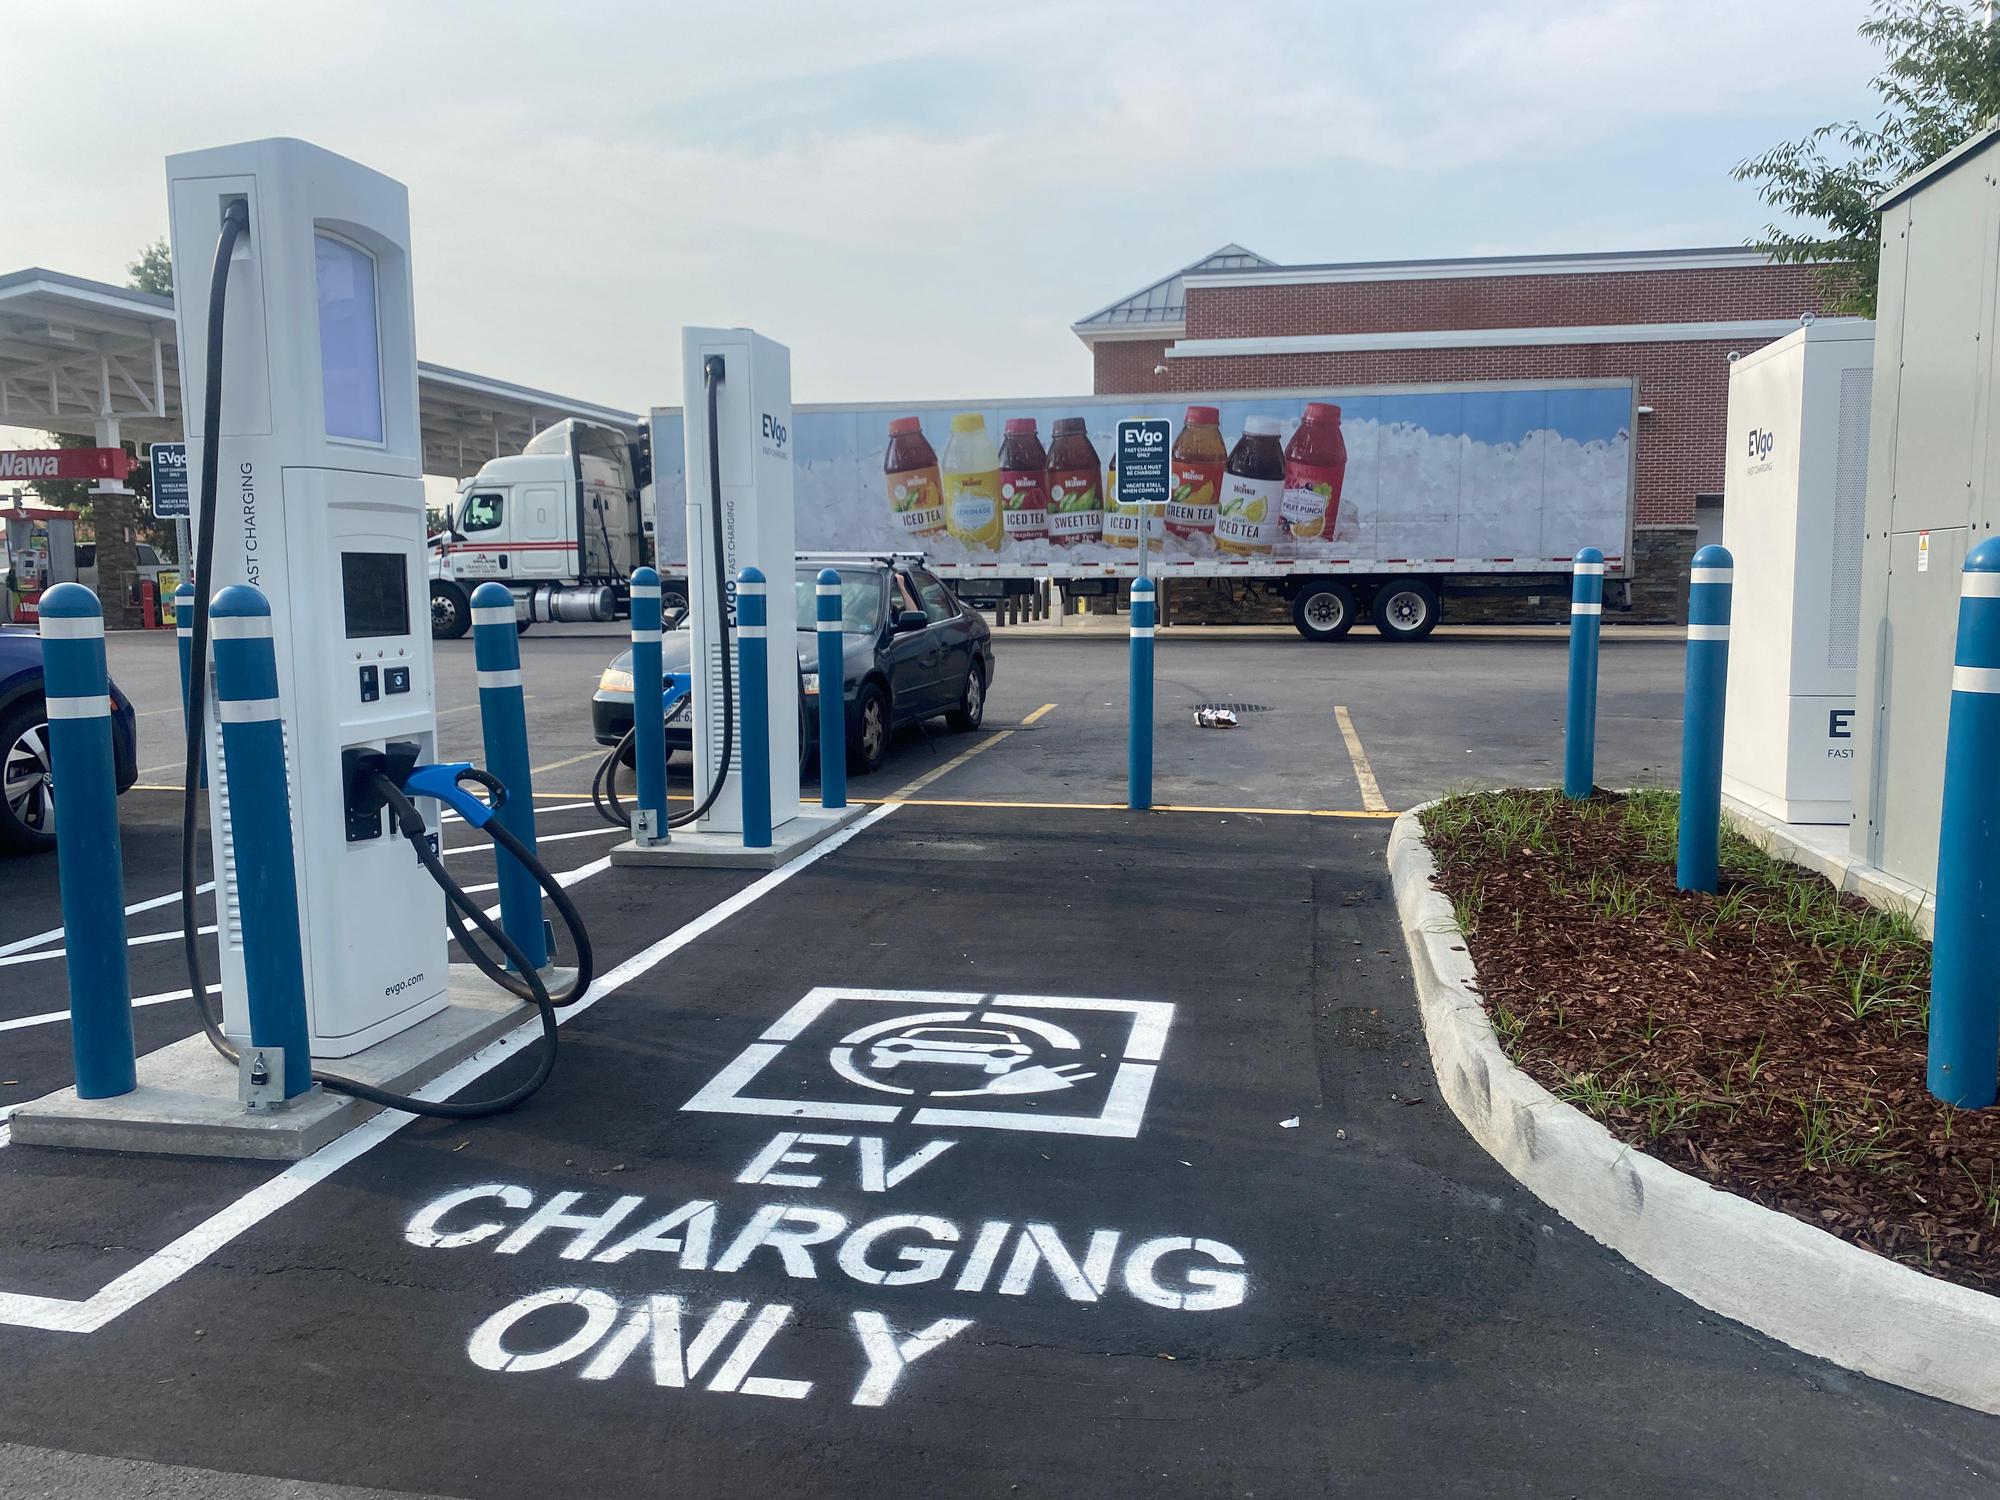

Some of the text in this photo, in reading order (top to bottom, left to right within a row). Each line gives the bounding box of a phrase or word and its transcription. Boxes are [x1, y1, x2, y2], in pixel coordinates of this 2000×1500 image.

[762, 412, 787, 448] EVgo
[1125, 429, 1163, 446] EVgo
[1749, 428, 1774, 461] EVgo
[1166, 504, 1212, 520] GREEN TEA
[1283, 502, 1323, 514] FRUIT PUNCH
[240, 462, 260, 586] AST CHARGING
[726, 500, 736, 550] CHARGING
[903, 510, 941, 526] ICED TEA
[1007, 512, 1044, 525] ICED TEA
[1054, 514, 1100, 528] SWEET TEA
[1110, 516, 1150, 532] ICED TA
[1218, 520, 1258, 538] ICED TEA
[1828, 749, 1854, 758] FAST
[385, 972, 424, 996] evgo.com
[736, 1131, 957, 1192] EV
[403, 1184, 1248, 1312] CHARGING
[466, 1286, 975, 1407] ONLY
